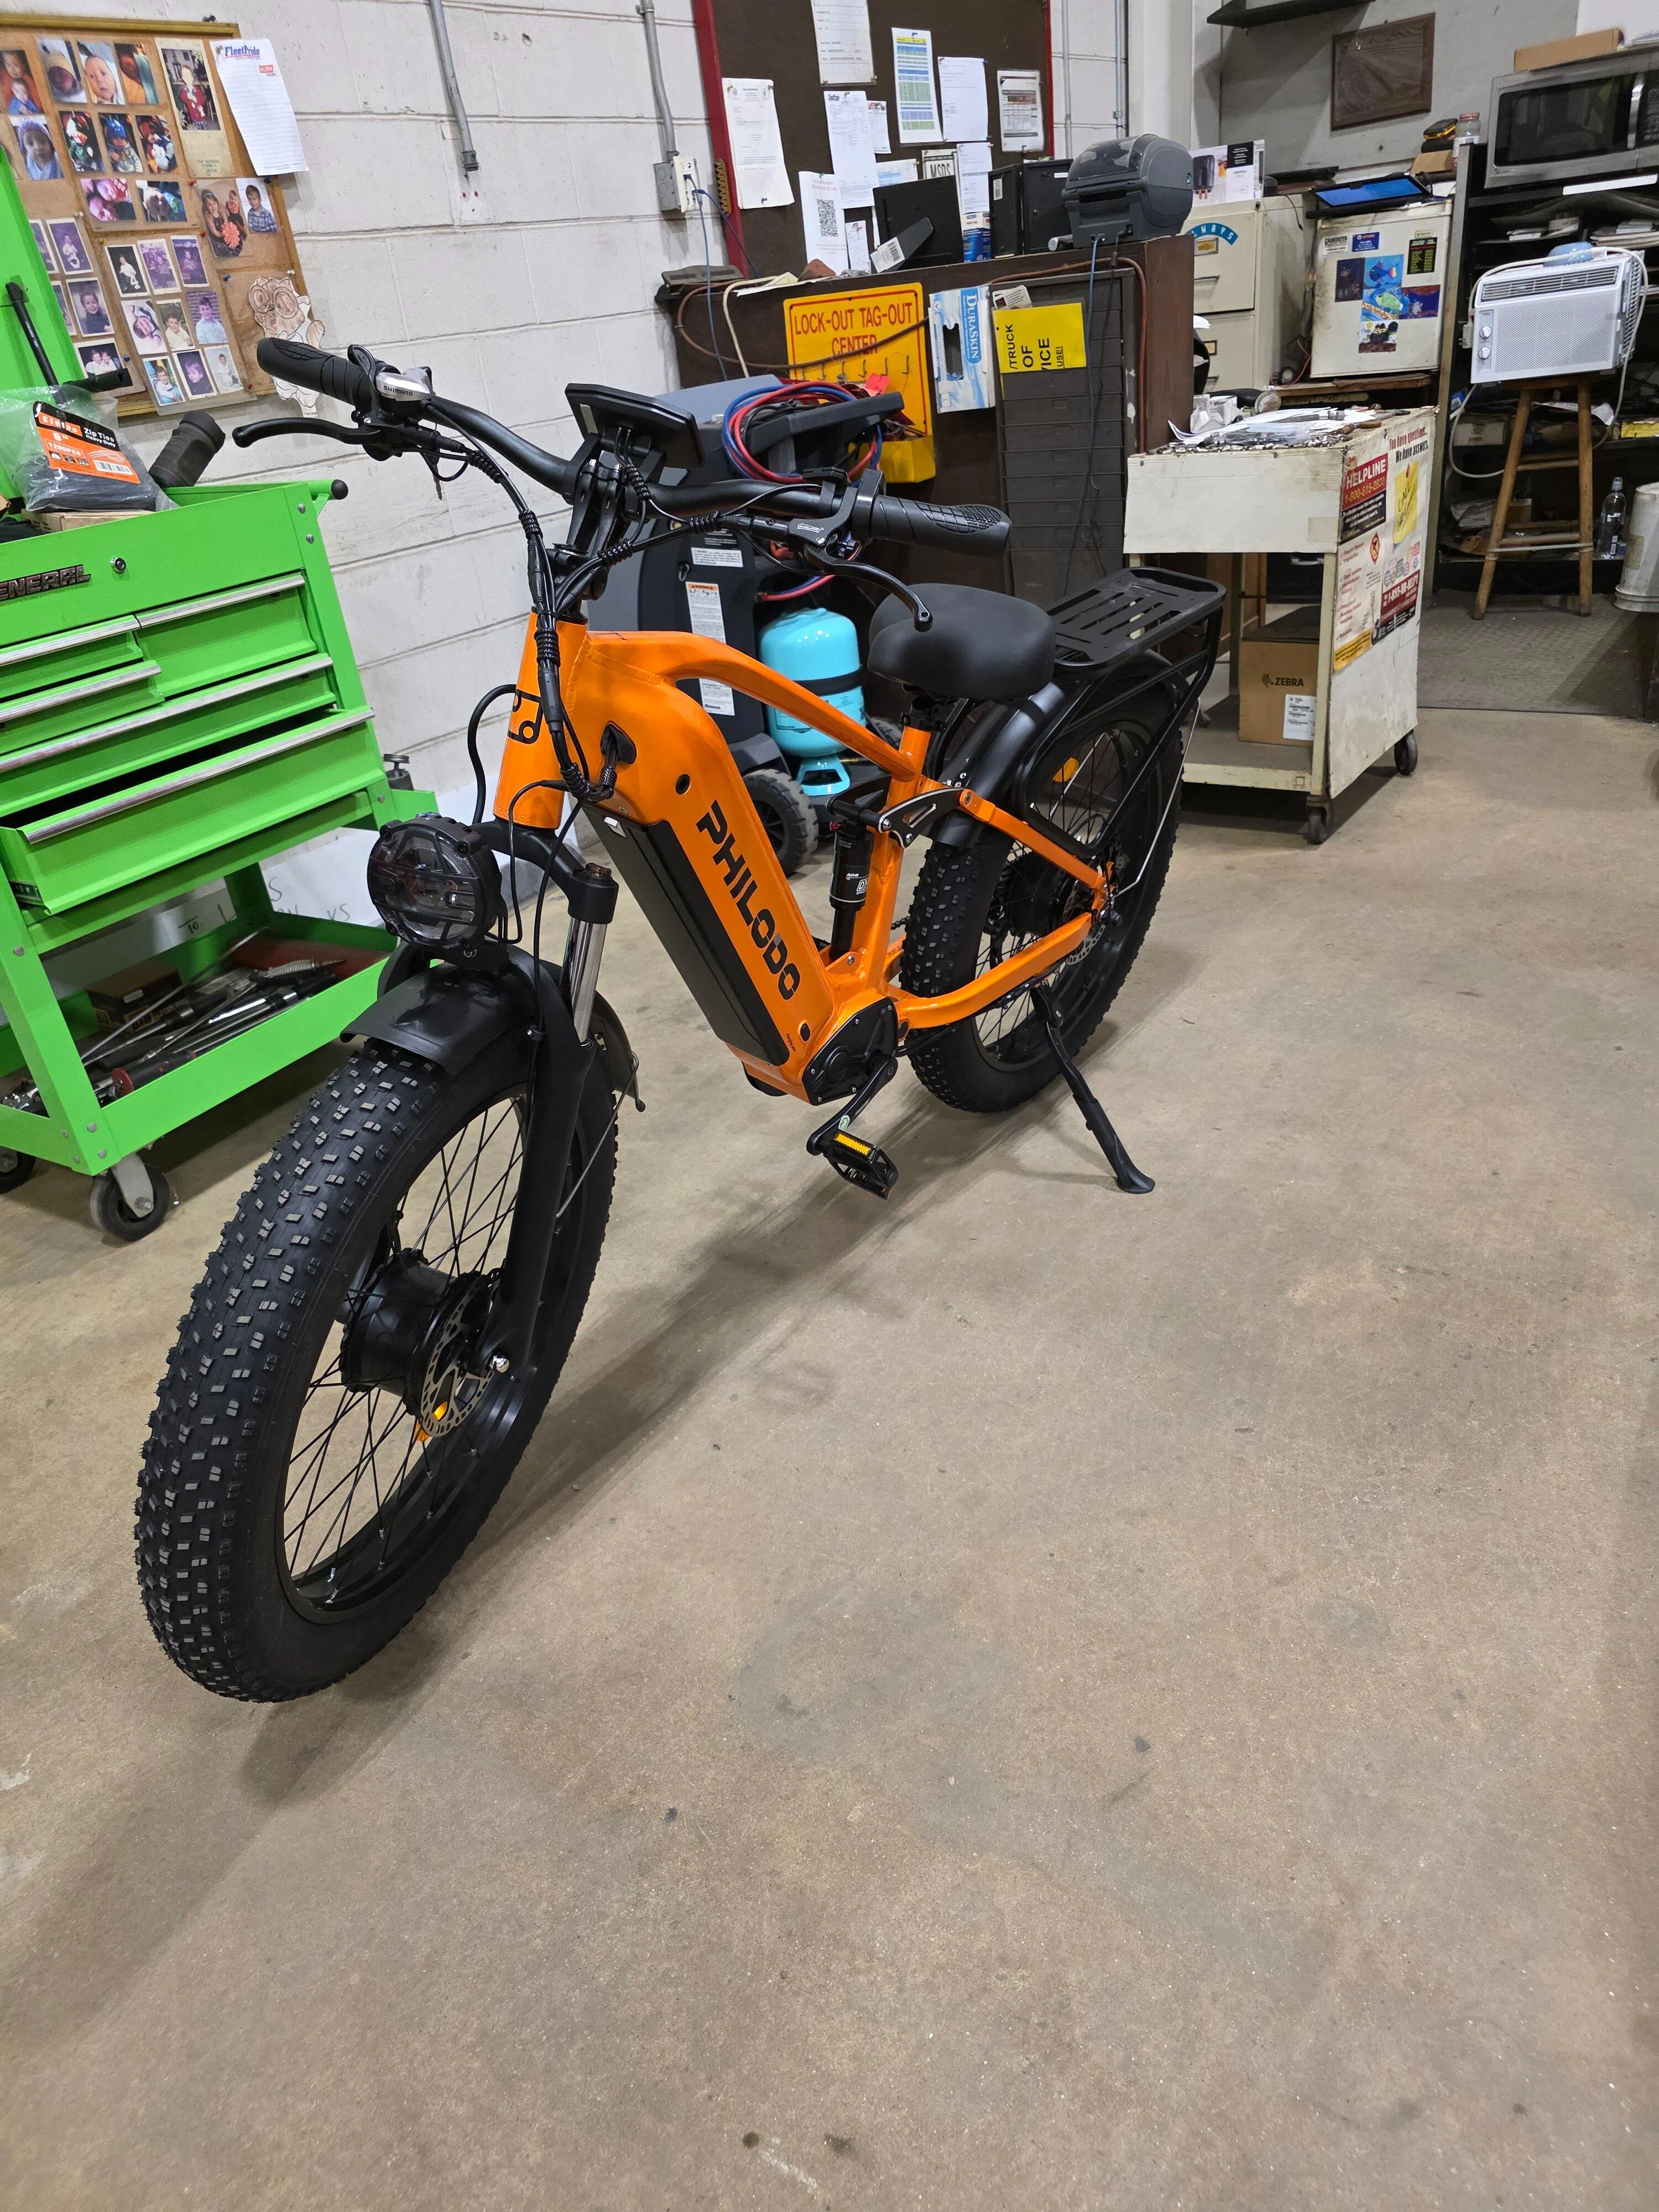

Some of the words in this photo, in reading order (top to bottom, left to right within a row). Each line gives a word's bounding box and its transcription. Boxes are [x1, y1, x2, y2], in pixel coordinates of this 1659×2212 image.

[225, 45, 260, 56] FleetPride
[930, 163, 951, 178] MSDS
[794, 309, 854, 335] LOCK-OUT
[859, 302, 912, 328] TAG-OUT
[967, 294, 979, 359] DURASKIN
[832, 334, 878, 357] CENTER
[1021, 345, 1034, 368] OF
[383, 385, 413, 396] SHIMANO
[53, 432, 62, 442] 8
[84, 427, 97, 437] Zip
[97, 431, 114, 442] Ties
[86, 435, 102, 444] Heavy
[103, 439, 116, 447] Duty
[1397, 434, 1407, 448] have
[1395, 451, 1402, 463] We
[1402, 445, 1412, 460] have
[1346, 458, 1386, 490] HELPLINE
[1275, 677, 1304, 687] ZEBRA
[696, 799, 801, 1001] PHILODO
